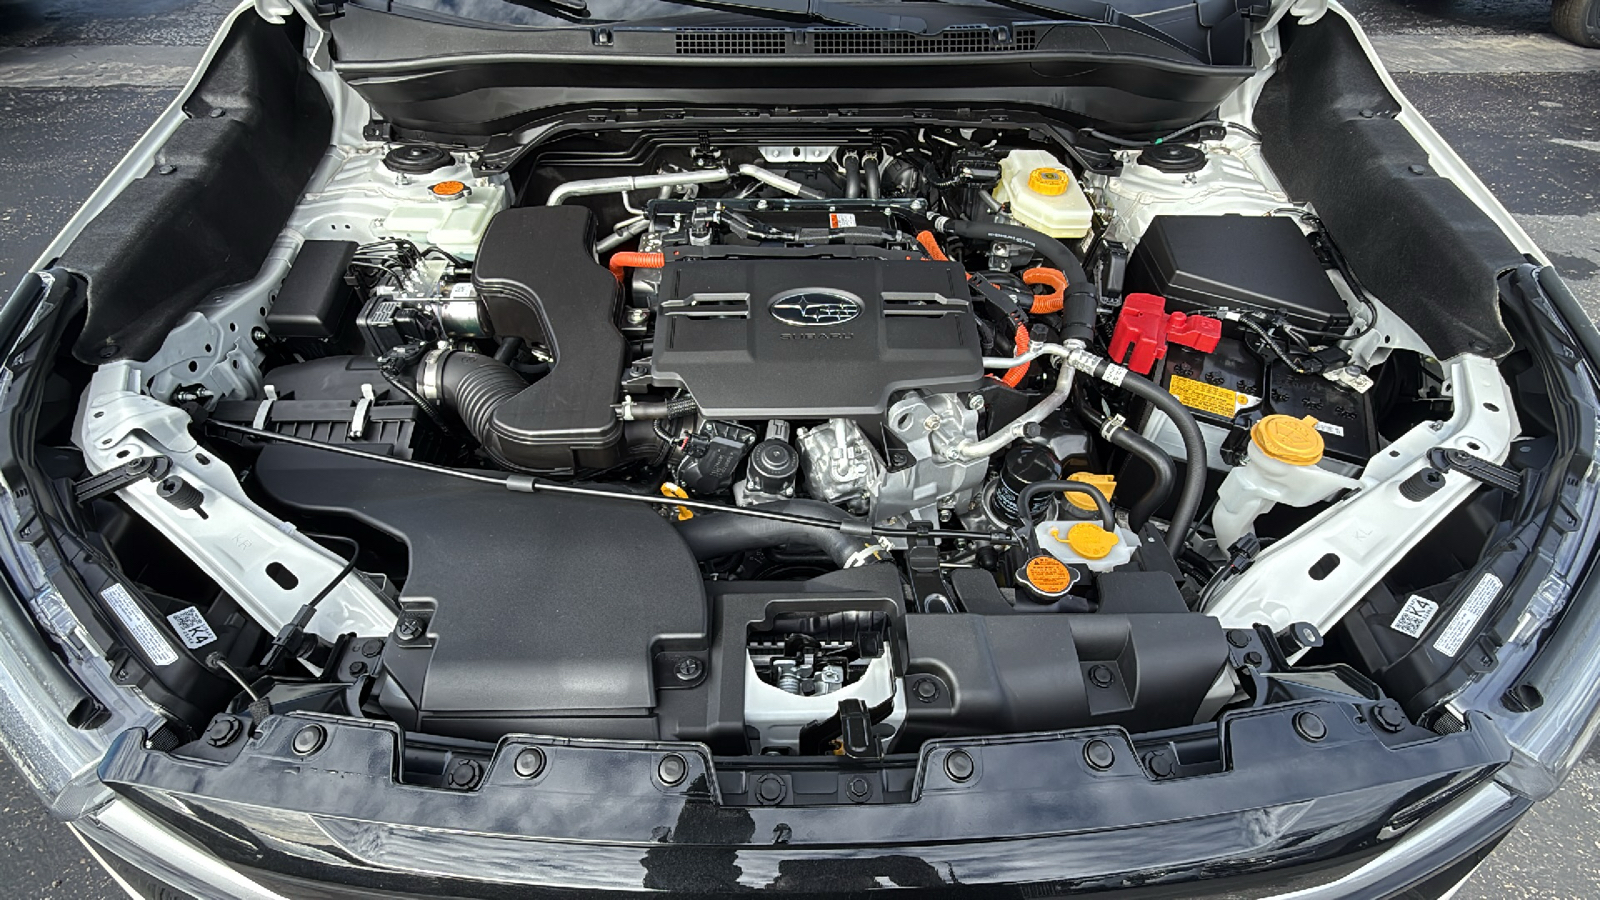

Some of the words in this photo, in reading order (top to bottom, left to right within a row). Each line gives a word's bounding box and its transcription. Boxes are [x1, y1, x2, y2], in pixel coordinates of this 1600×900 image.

[231, 532, 253, 551] KR
[1352, 529, 1373, 542] KL
[1409, 599, 1430, 617] K4
[188, 626, 209, 643] K4
